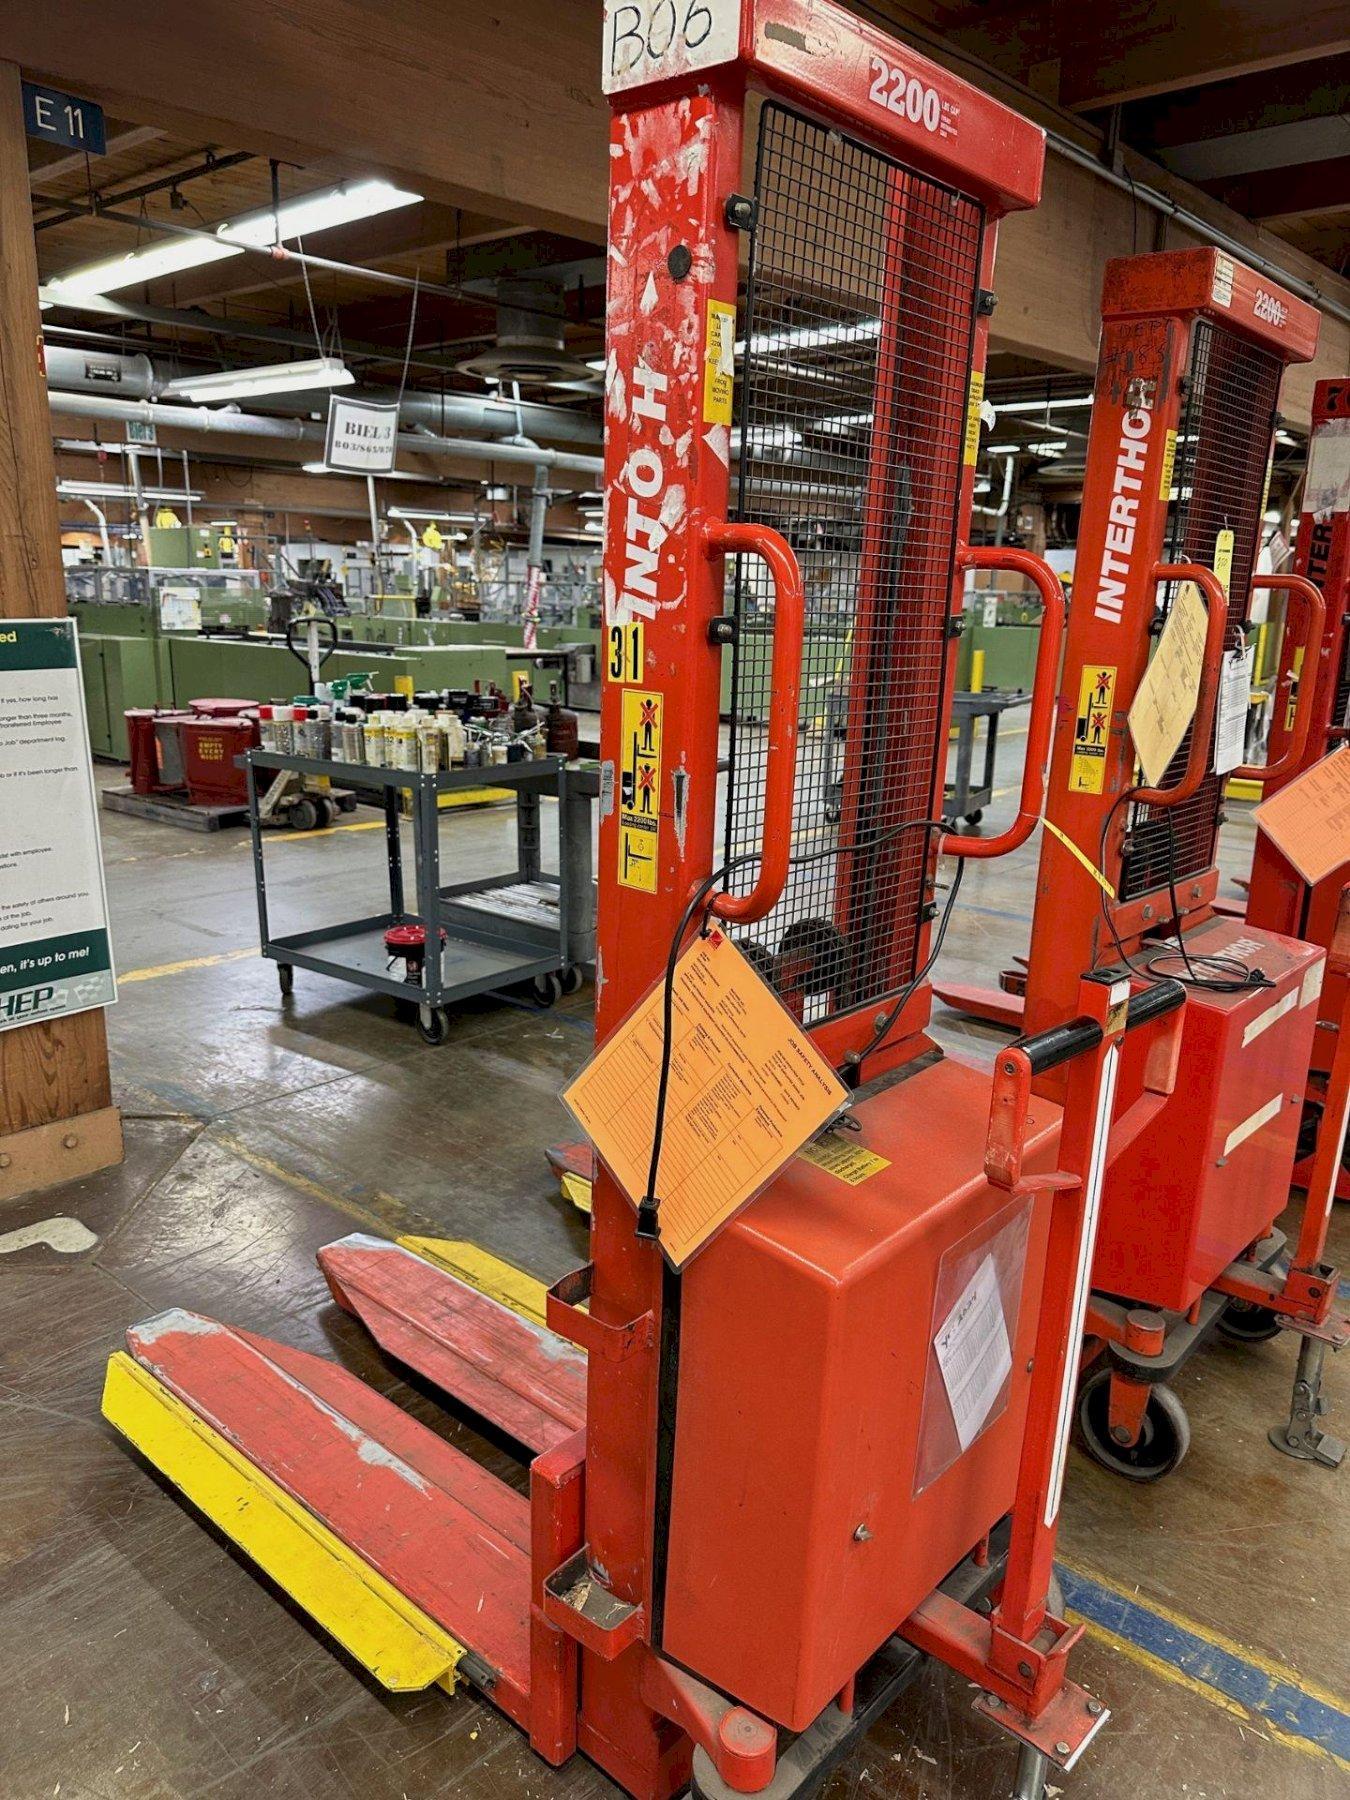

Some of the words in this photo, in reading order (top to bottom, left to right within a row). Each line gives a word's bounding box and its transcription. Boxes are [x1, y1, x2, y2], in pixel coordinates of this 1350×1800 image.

[610, 0, 713, 77] B06
[869, 57, 940, 133] 2200
[35, 95, 57, 131] E
[63, 105, 84, 139] 11
[1252, 288, 1282, 327] 2200
[345, 422, 380, 440] BIEL
[33, 719, 62, 727] Employee
[19, 737, 54, 745] department
[44, 767, 63, 775] longer
[13, 900, 29, 909] safety
[56, 892, 77, 901] around
[30, 918, 42, 926] your
[20, 957, 35, 970] it's
[38, 955, 52, 967] up
[55, 952, 65, 962] to
[68, 946, 90, 959] me!
[787, 1037, 798, 1050] JOB
[796, 1047, 813, 1069] SAFETY
[811, 1068, 833, 1096] ANALYSIS
